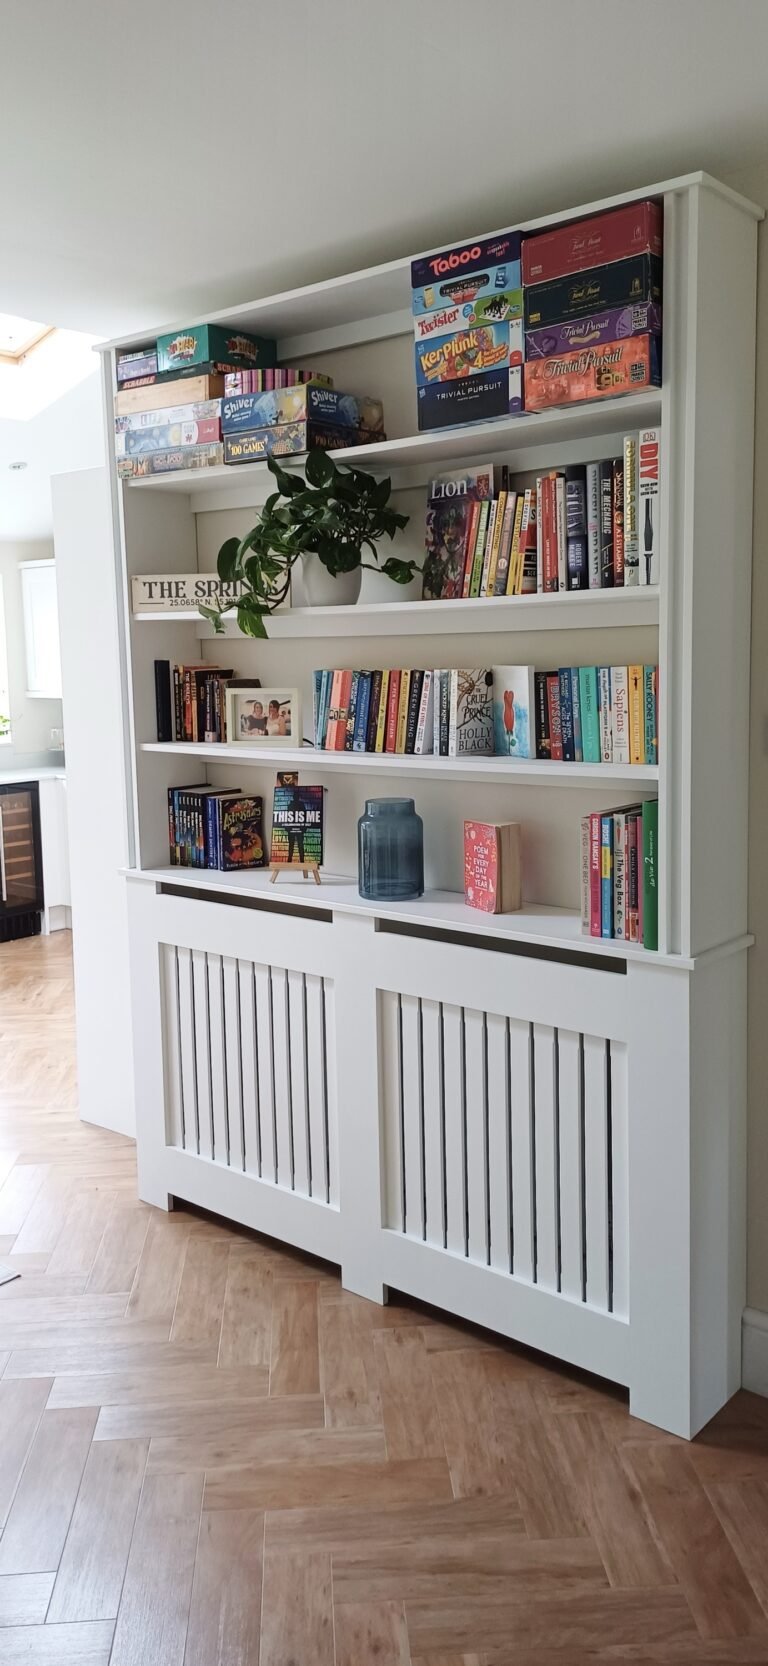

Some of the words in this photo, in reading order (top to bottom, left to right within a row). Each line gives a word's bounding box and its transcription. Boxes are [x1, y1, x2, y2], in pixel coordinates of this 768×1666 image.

[430, 246, 482, 276] Taboo
[418, 308, 460, 336] Twister
[420, 330, 478, 372] KerPlunk
[543, 359, 580, 380] Trivial
[578, 346, 624, 376] Pursuit
[311, 390, 338, 406] Shiver
[436, 390, 466, 400] TRIVIAL
[468, 382, 502, 394] PURSUIT
[224, 398, 254, 420] Shiver
[231, 445, 242, 456] 100
[244, 442, 265, 454] GAMES
[640, 443, 658, 480] DIY
[626, 440, 635, 503] FORMULA
[431, 479, 467, 499] Lion
[626, 506, 635, 532] ONE
[143, 580, 186, 598] THE
[466, 694, 488, 704] CRUEL
[551, 686, 560, 733] BRYSON
[614, 688, 625, 733] Sapiens
[460, 727, 492, 740] HOLLY
[459, 740, 492, 751] BLACK
[273, 811, 294, 823] THIS
[294, 811, 304, 822] IS
[306, 811, 320, 822] ME
[473, 845, 488, 855] POEM
[474, 858, 489, 866] EVERY
[476, 866, 486, 875] DAY
[475, 880, 488, 889] YEAR
[615, 874, 624, 889] Veg
